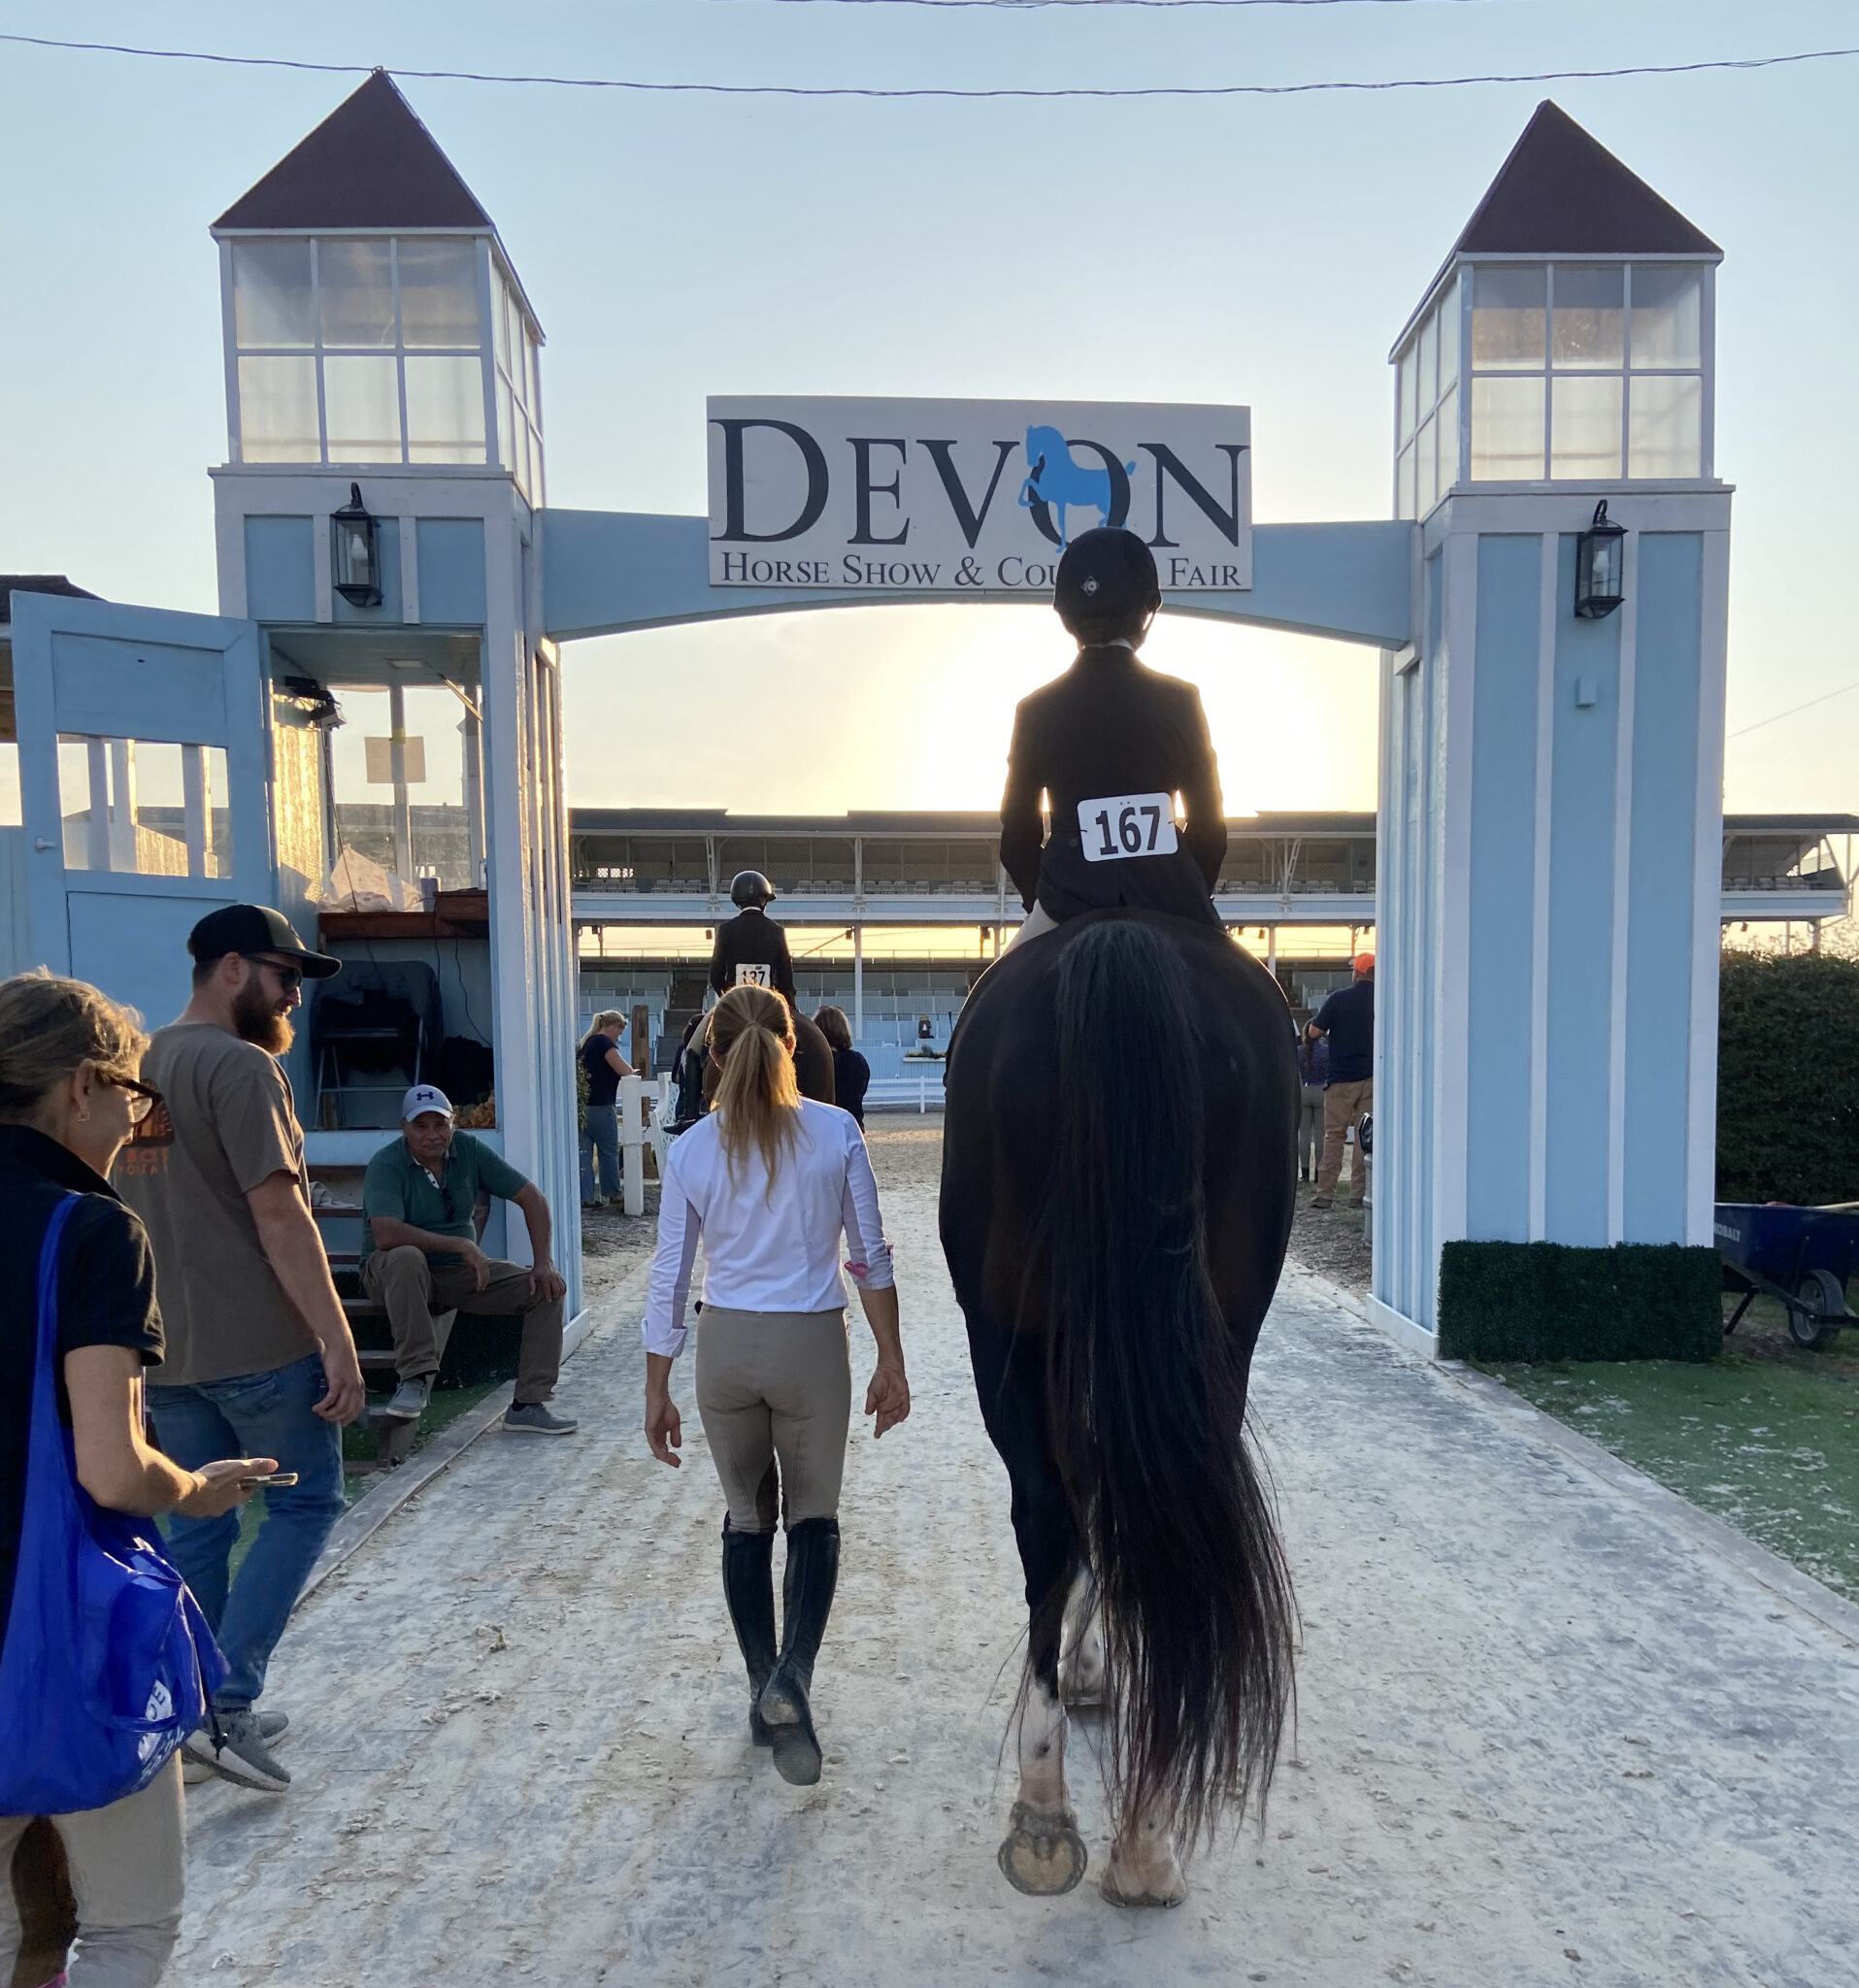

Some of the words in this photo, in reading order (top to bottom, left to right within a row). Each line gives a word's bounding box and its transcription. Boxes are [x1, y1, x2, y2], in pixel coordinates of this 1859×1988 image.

[709, 418, 1250, 548] DEVON
[721, 551, 830, 583] HORSE
[843, 553, 942, 585] SHOW
[953, 556, 984, 586] &
[1168, 557, 1242, 586] FAIR
[1095, 806, 1160, 855] 167
